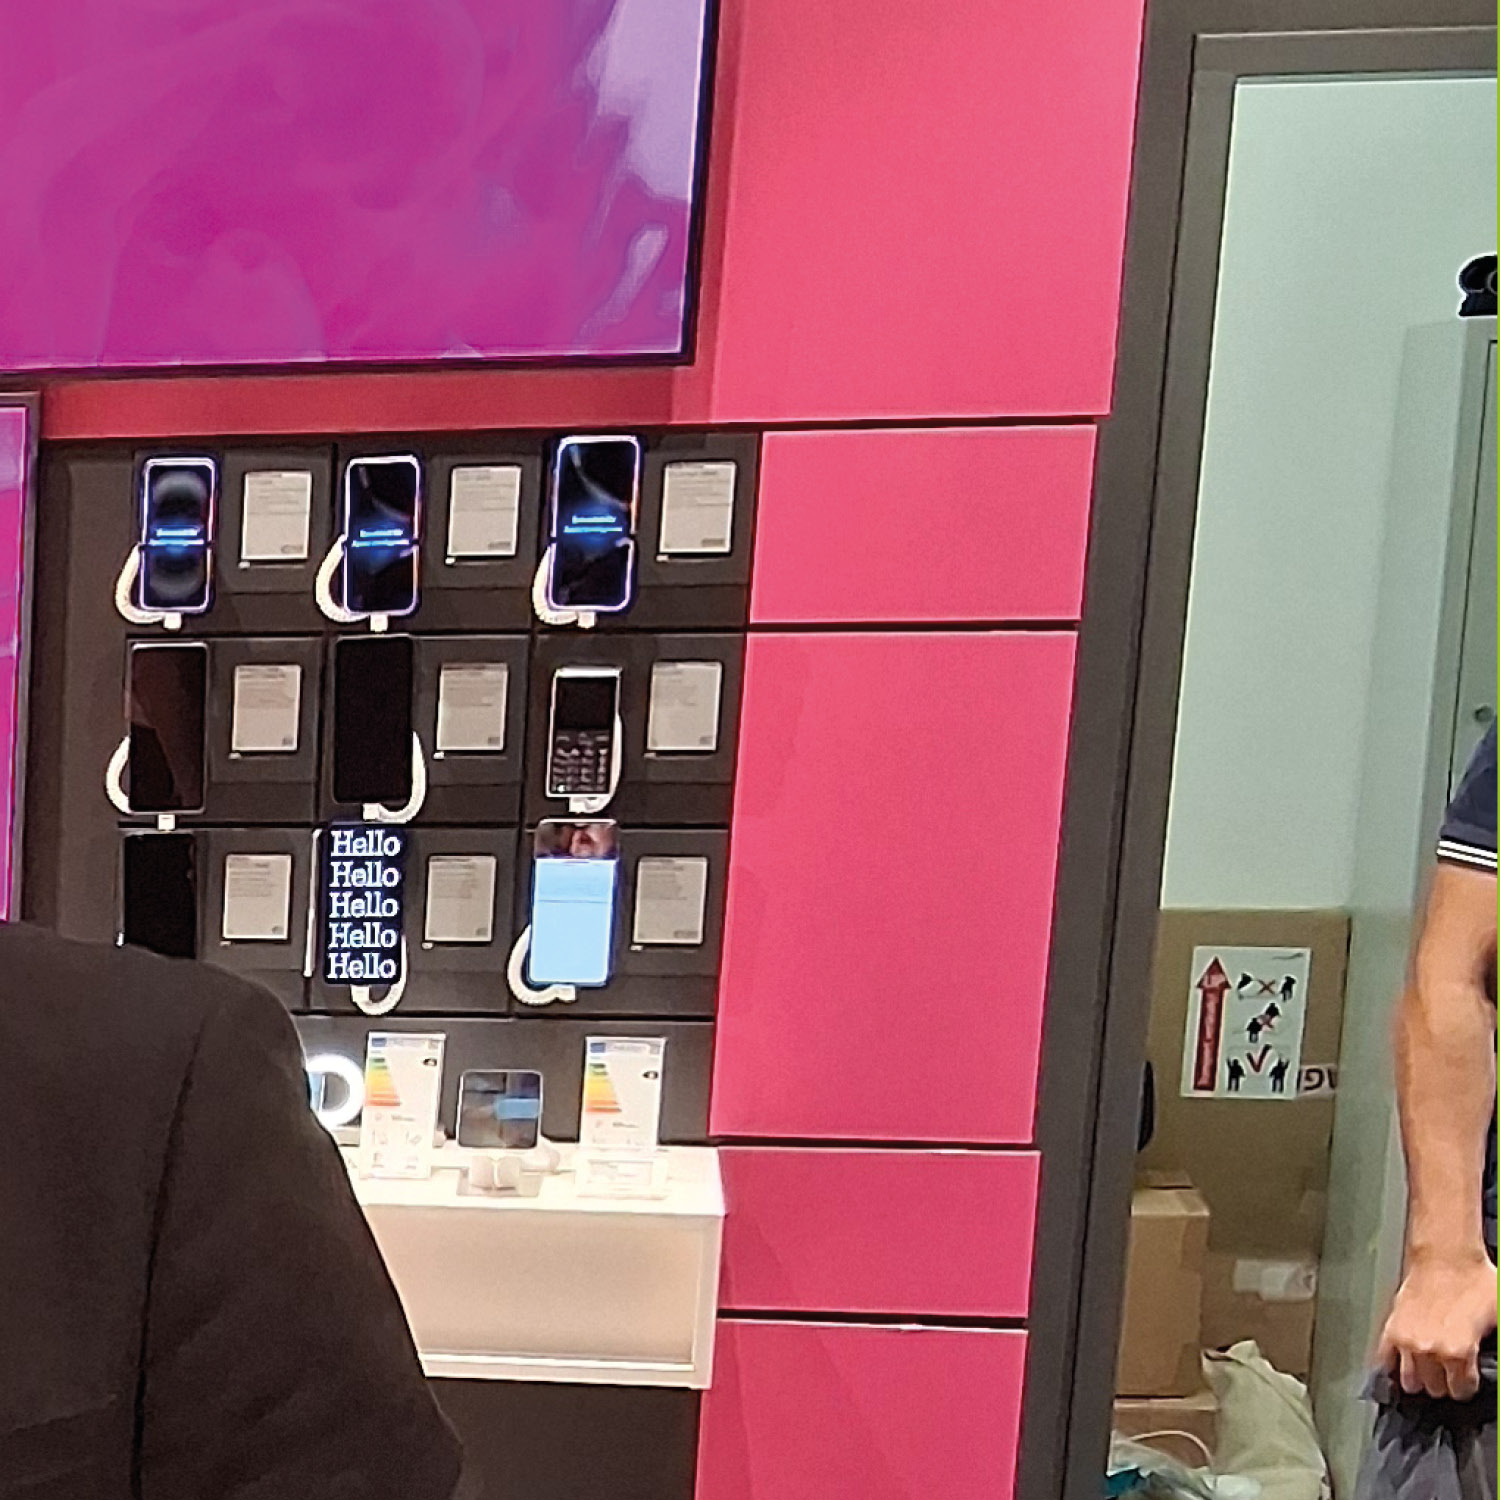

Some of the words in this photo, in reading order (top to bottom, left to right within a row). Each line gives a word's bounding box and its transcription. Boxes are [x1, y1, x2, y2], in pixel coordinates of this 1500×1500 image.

[330, 829, 401, 857] Hello
[329, 861, 400, 888] Hello
[329, 891, 399, 918] Hello
[328, 922, 397, 949] Hello
[327, 952, 396, 979] Hello
